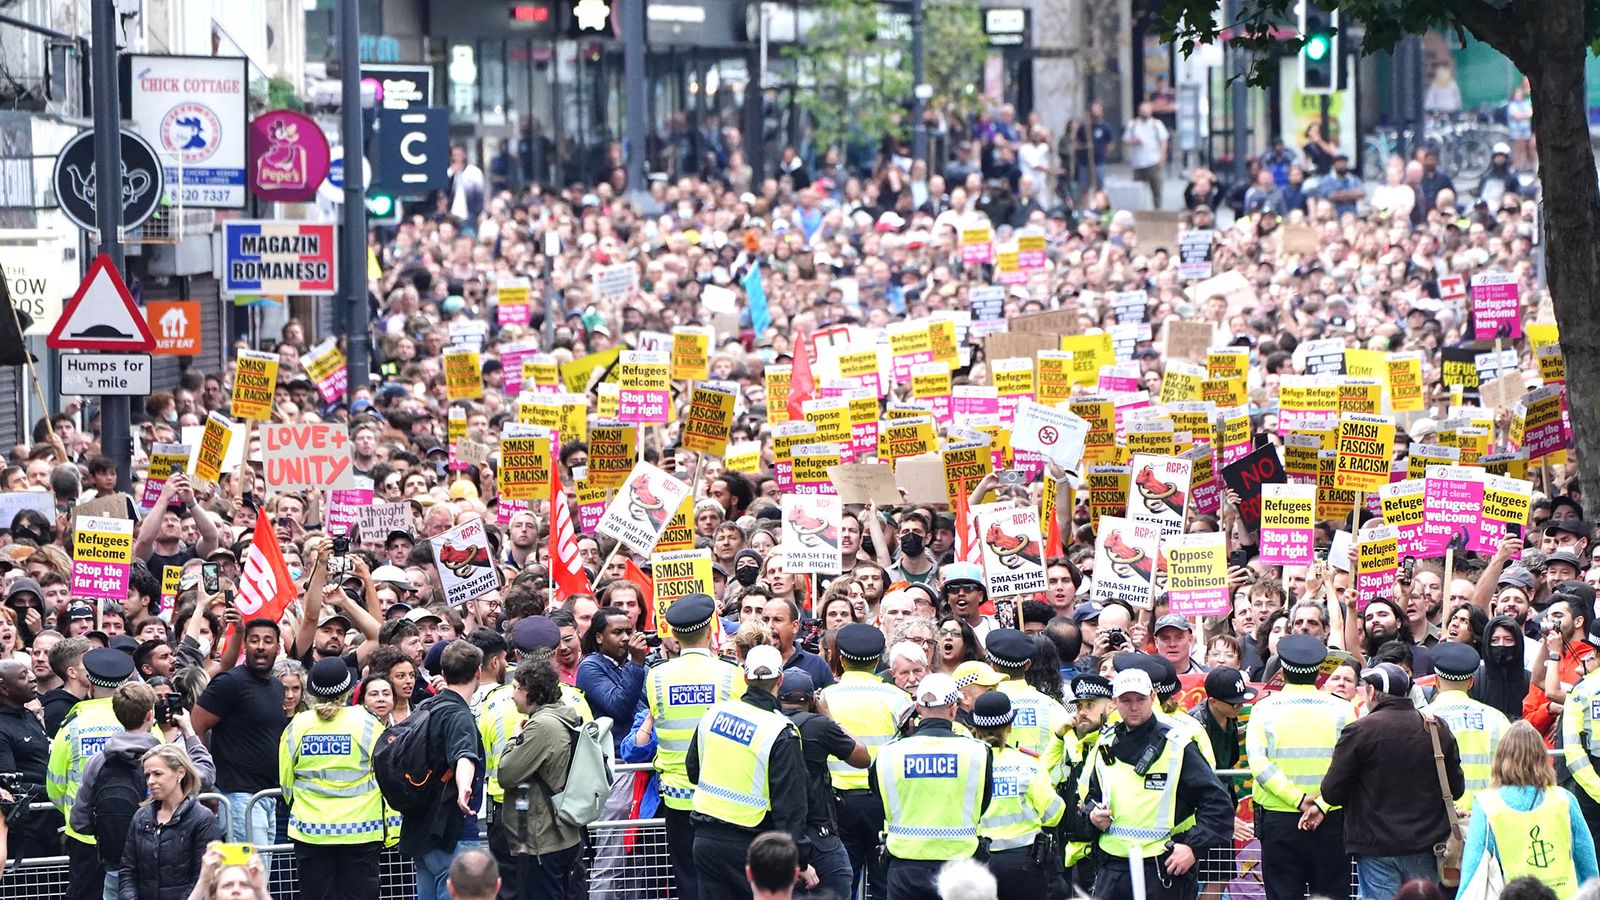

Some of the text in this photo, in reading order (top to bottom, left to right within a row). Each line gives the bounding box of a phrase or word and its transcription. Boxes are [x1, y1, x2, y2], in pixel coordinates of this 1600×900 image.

[141, 78, 240, 93] CHICK COTTAGE
[400, 132, 427, 165] C
[262, 169, 298, 182] Pepe's
[203, 190, 230, 201] 7337
[242, 236, 319, 254] MAGAZIN
[232, 262, 328, 281] ROMANESC
[12, 298, 44, 315] OS
[1475, 299, 1517, 310] Refugees
[1475, 309, 1516, 318] welcome
[1476, 320, 1497, 329] here
[156, 340, 194, 348] UST EAT
[68, 360, 143, 373] Humps for
[240, 359, 266, 371] SMASH
[1209, 356, 1236, 365] SMASH
[622, 366, 667, 377] Refugees
[1443, 361, 1476, 374] REFUG
[238, 374, 269, 387] FASCISM
[996, 373, 1032, 382] Refugees
[1167, 372, 1179, 380] NO
[1444, 375, 1478, 387] WELCO
[98, 377, 127, 388] mile
[622, 378, 664, 387] welcome
[1202, 382, 1229, 392] SMASH
[622, 392, 663, 404] Stop the
[1178, 391, 1187, 399] TO
[1339, 388, 1368, 396] SMASH
[694, 391, 722, 406] SMASH
[522, 405, 558, 416] Refugees
[621, 404, 662, 415] far right
[1339, 401, 1374, 411] FASCISM
[690, 406, 726, 421] FASCISM
[807, 411, 840, 421] Oppose
[592, 430, 622, 440] SMASH
[888, 427, 918, 440] SMASH
[1343, 423, 1378, 438] SMASH
[1526, 424, 1559, 441] Stop the
[1129, 435, 1172, 445] Refugees
[503, 441, 534, 452] SMASH
[590, 444, 628, 455] FASCISM
[890, 441, 926, 455] FASCISM
[1341, 440, 1384, 455] FASCISM
[945, 450, 976, 464] SMASH
[1286, 448, 1318, 459] Refugees
[504, 456, 542, 467] FASCISM
[590, 459, 632, 469] & RACISM
[794, 458, 838, 468] Refugees
[1286, 460, 1317, 470] welcome
[1339, 457, 1389, 472] & RACISM
[268, 455, 350, 486] UNITY
[504, 470, 548, 482] & RACISM
[947, 465, 986, 479] FASCISM
[1241, 457, 1274, 490] NO
[1091, 477, 1118, 487] SMASH
[1091, 492, 1125, 502] FASCISM
[1427, 489, 1440, 497] Say
[1450, 490, 1470, 498] clear:
[1264, 500, 1311, 513] Refugees
[1426, 497, 1480, 511] Refugees
[365, 504, 405, 520] thought
[581, 506, 603, 516] Stop
[361, 517, 405, 528] all lives
[1264, 514, 1310, 524] welcome
[1426, 511, 1476, 524] welcome
[609, 514, 654, 542] SMASH THE
[1425, 522, 1452, 535] here
[78, 533, 129, 547] Refugees
[1263, 532, 1308, 545] Stop the
[78, 547, 126, 559] welcome
[1263, 545, 1307, 558] far right
[1362, 543, 1396, 556] Refugees
[1170, 550, 1213, 563] Oppose
[1362, 557, 1394, 568] welcome
[75, 564, 122, 577] Stop the
[656, 563, 694, 578] SMASH
[1171, 564, 1212, 575] Tommy
[74, 576, 120, 591] far right
[990, 571, 1044, 584] SMASH THE
[1172, 576, 1225, 587] Robinson
[1360, 573, 1394, 588] Stop the
[448, 572, 494, 596] SMASH THE
[657, 580, 704, 596] FASCISM
[992, 580, 1045, 593] FAR RIGHT!
[1097, 580, 1149, 594] SMASH THE
[450, 580, 496, 604] FAR RIGHT!
[1096, 590, 1148, 604] FAR RIGHT!
[1360, 589, 1374, 600] far
[671, 692, 712, 704] POLICE
[713, 714, 754, 742] POLICE
[302, 735, 350, 743] METROPOLITAN
[301, 743, 350, 755] POLICE
[906, 757, 955, 774] POLICE
